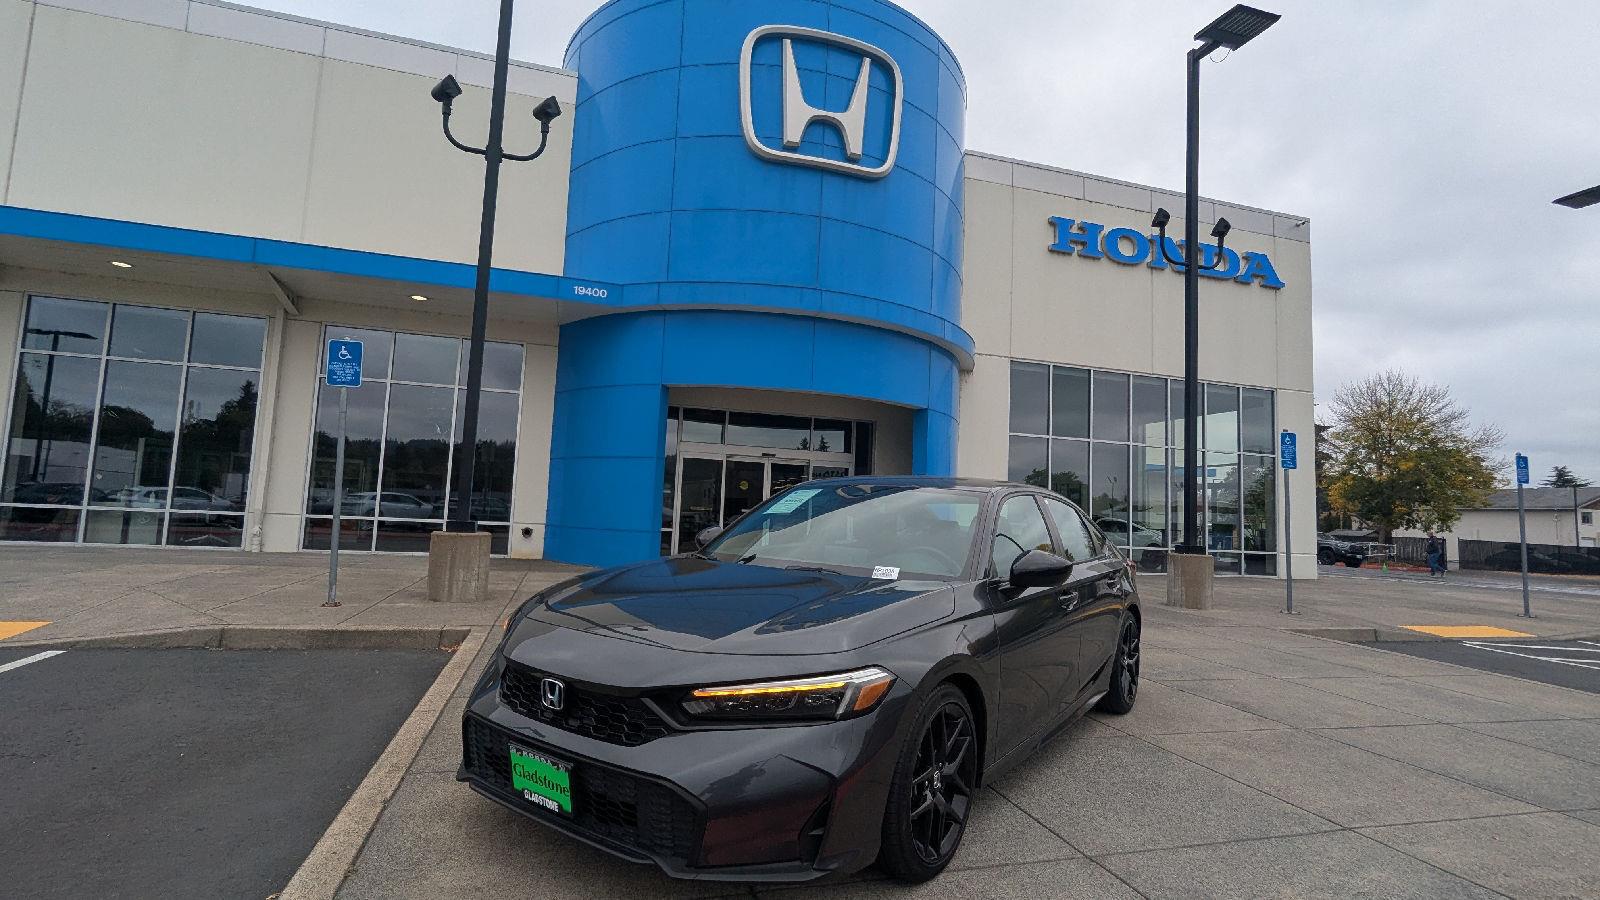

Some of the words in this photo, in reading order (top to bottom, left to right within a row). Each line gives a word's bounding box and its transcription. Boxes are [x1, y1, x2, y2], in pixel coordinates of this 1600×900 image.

[1048, 215, 1286, 290] HONDA
[573, 285, 608, 298] 19400
[513, 762, 570, 797] Gladstone
[523, 789, 559, 812] GLADSTONE
